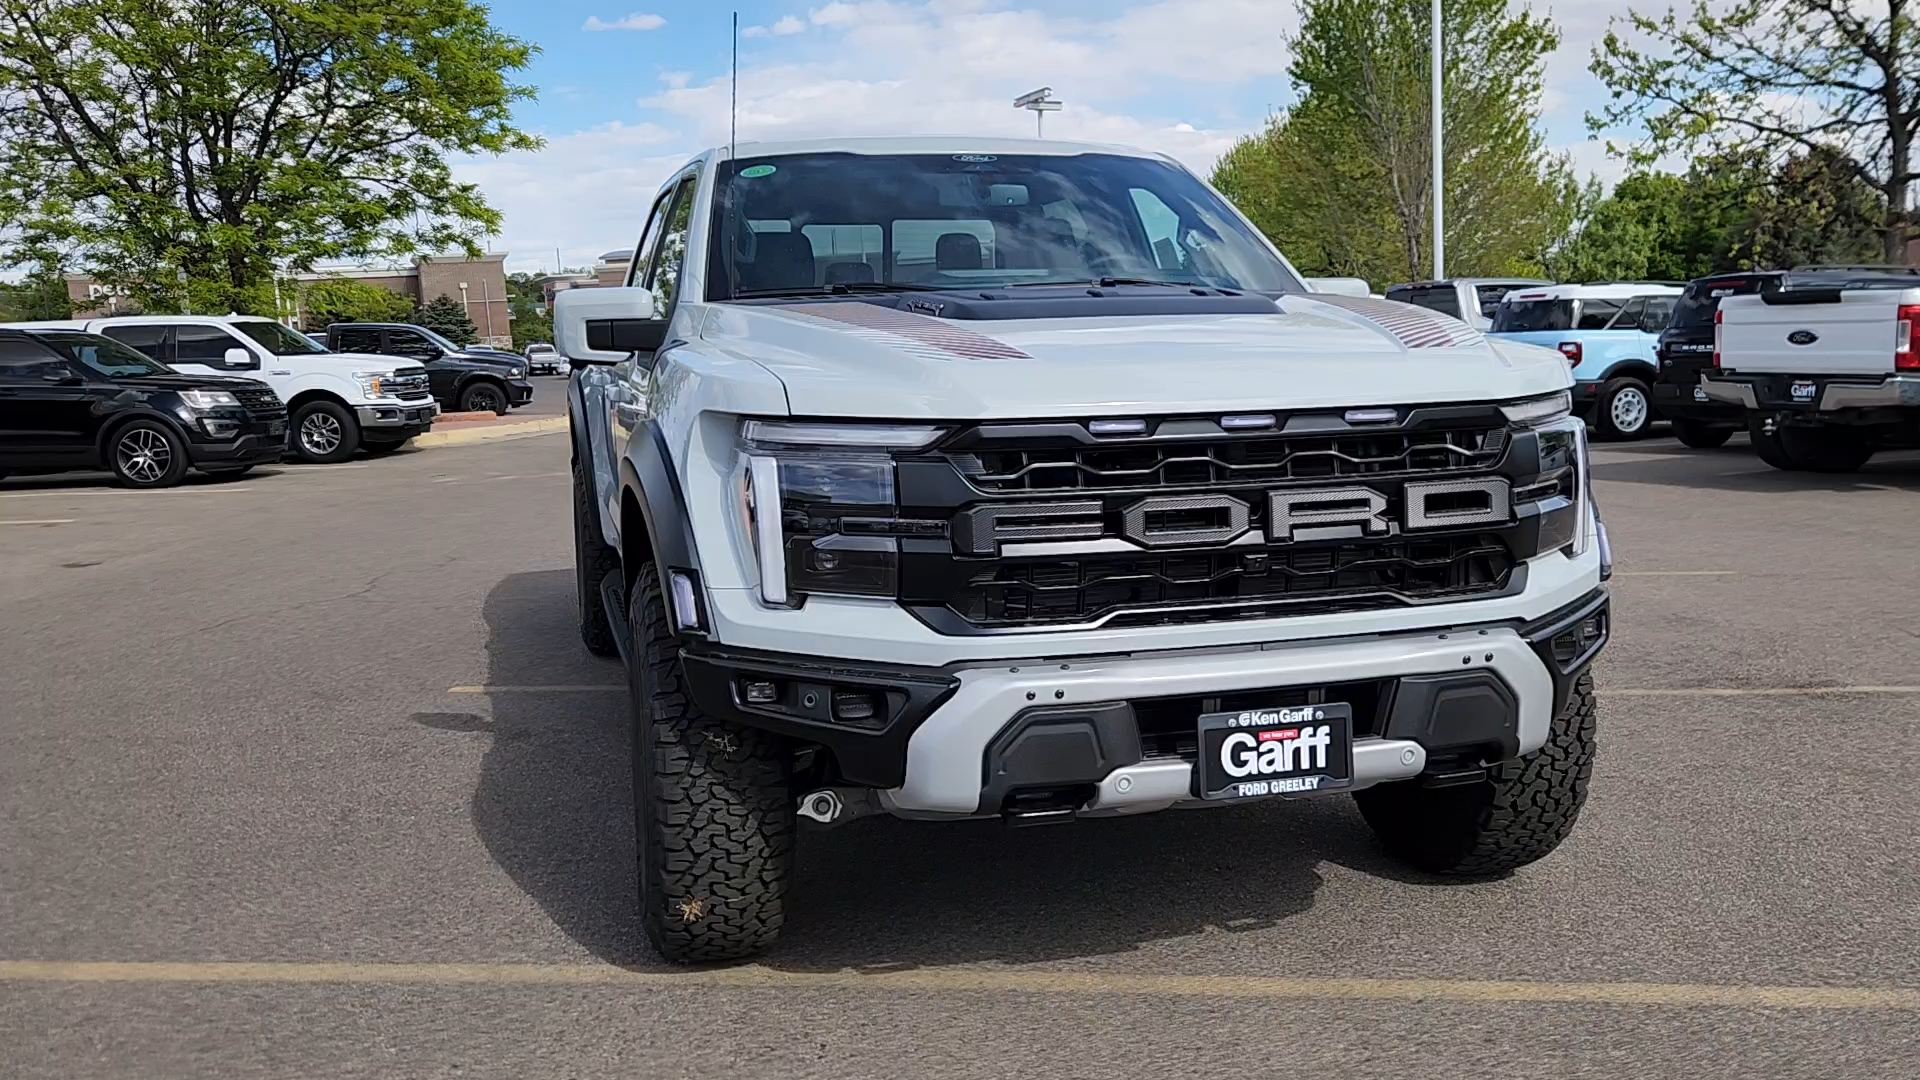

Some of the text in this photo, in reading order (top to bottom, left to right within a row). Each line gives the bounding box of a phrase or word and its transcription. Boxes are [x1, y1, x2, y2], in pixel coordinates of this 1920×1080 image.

[956, 477, 1510, 557] FORD
[1251, 711, 1278, 726] Ken
[1279, 707, 1314, 723] Garff
[1221, 725, 1330, 777] Garff
[1238, 776, 1319, 796] FORD GREELEY
